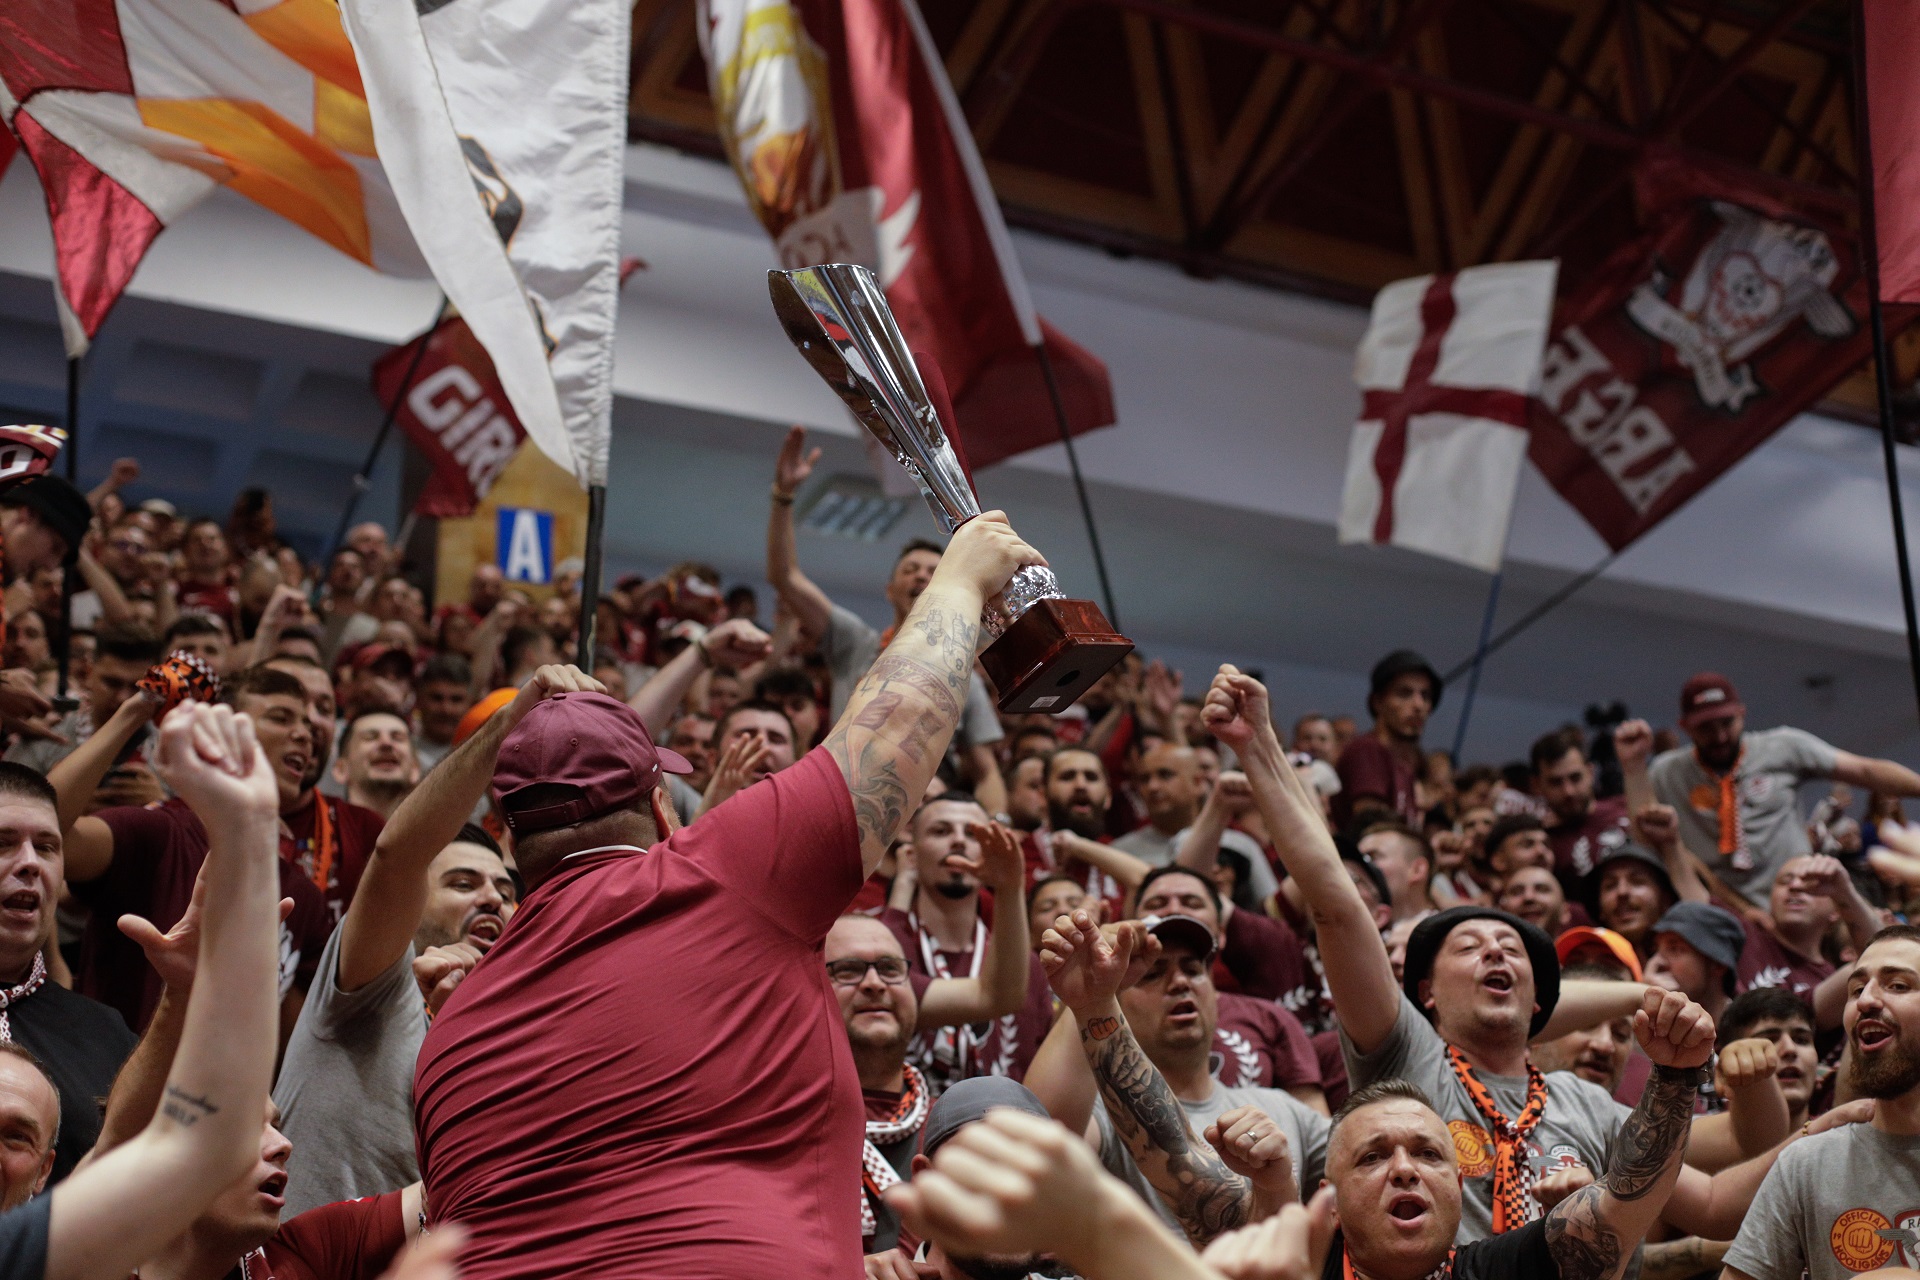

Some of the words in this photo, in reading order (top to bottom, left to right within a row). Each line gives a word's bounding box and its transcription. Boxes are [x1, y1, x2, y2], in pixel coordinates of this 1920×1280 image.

[407, 364, 517, 498] GIR
[505, 508, 547, 584] A
[1839, 1211, 1888, 1229] OFFICIAL
[1833, 1232, 1841, 1240] 19
[1834, 1245, 1890, 1269] HOOLIGANS
